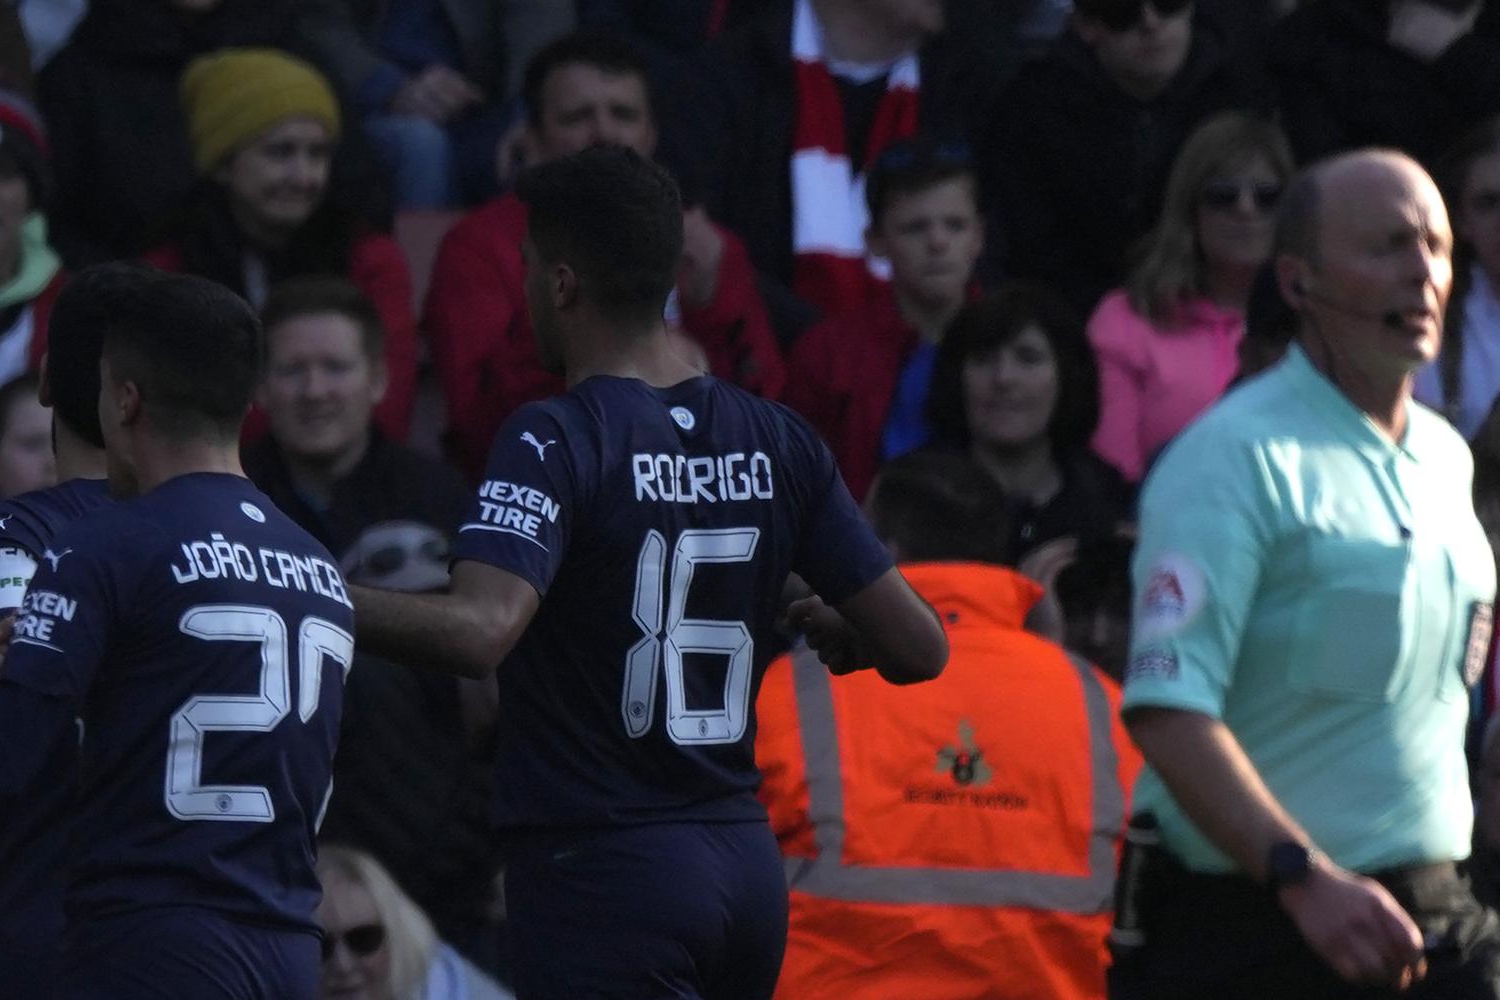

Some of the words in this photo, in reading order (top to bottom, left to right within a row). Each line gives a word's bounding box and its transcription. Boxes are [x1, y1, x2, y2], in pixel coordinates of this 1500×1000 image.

[479, 480, 561, 523] NEXEN
[631, 452, 774, 504] RODRIGO
[480, 501, 542, 536] TIRE
[171, 532, 258, 584] JOÃO
[19, 591, 78, 621] EXEN
[621, 527, 761, 746] 16
